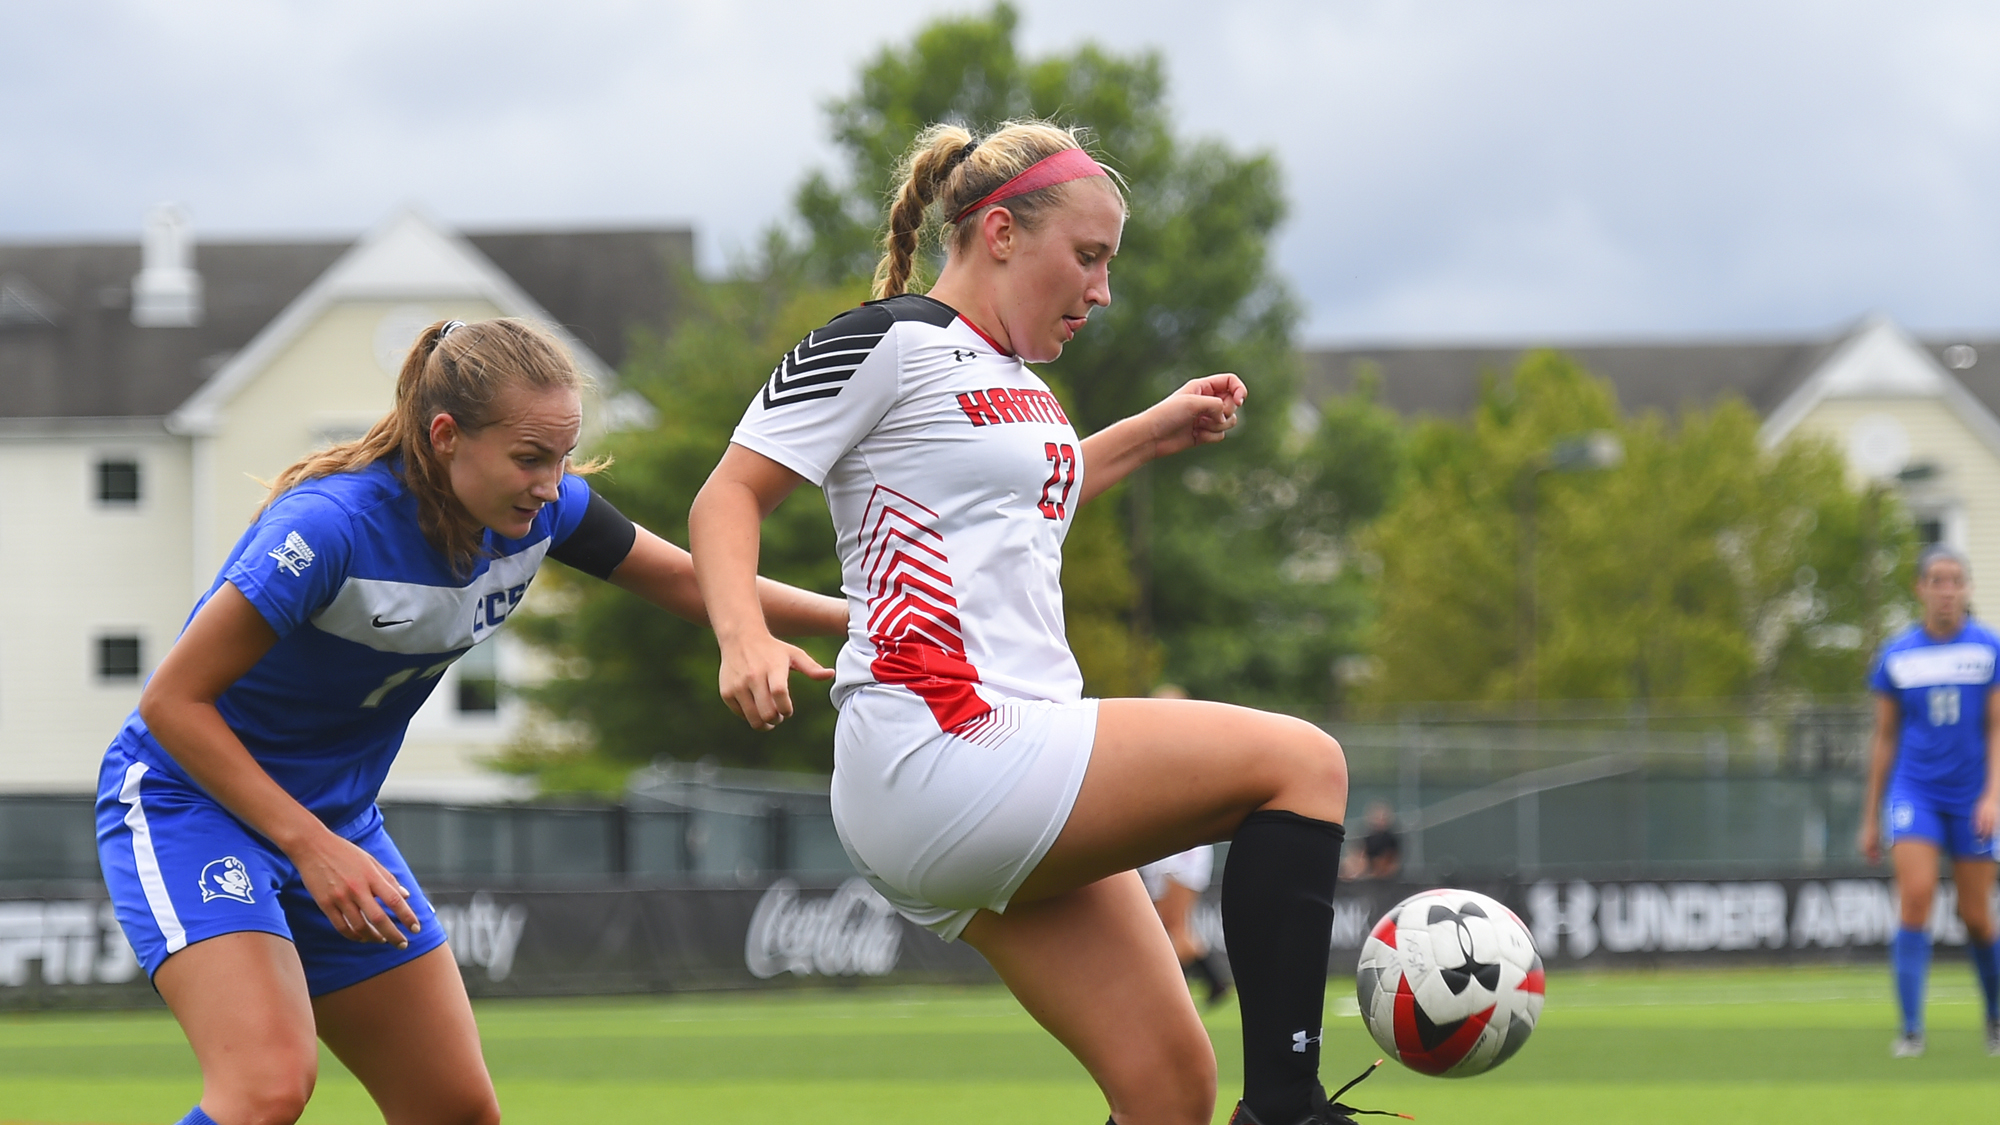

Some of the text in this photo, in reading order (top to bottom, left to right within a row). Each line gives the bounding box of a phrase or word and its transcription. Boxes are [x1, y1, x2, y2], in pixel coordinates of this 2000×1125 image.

[1037, 442, 1075, 520] 23
[272, 542, 311, 570] NEC
[473, 574, 535, 633] CCS
[1601, 882, 1788, 952] UNDER
